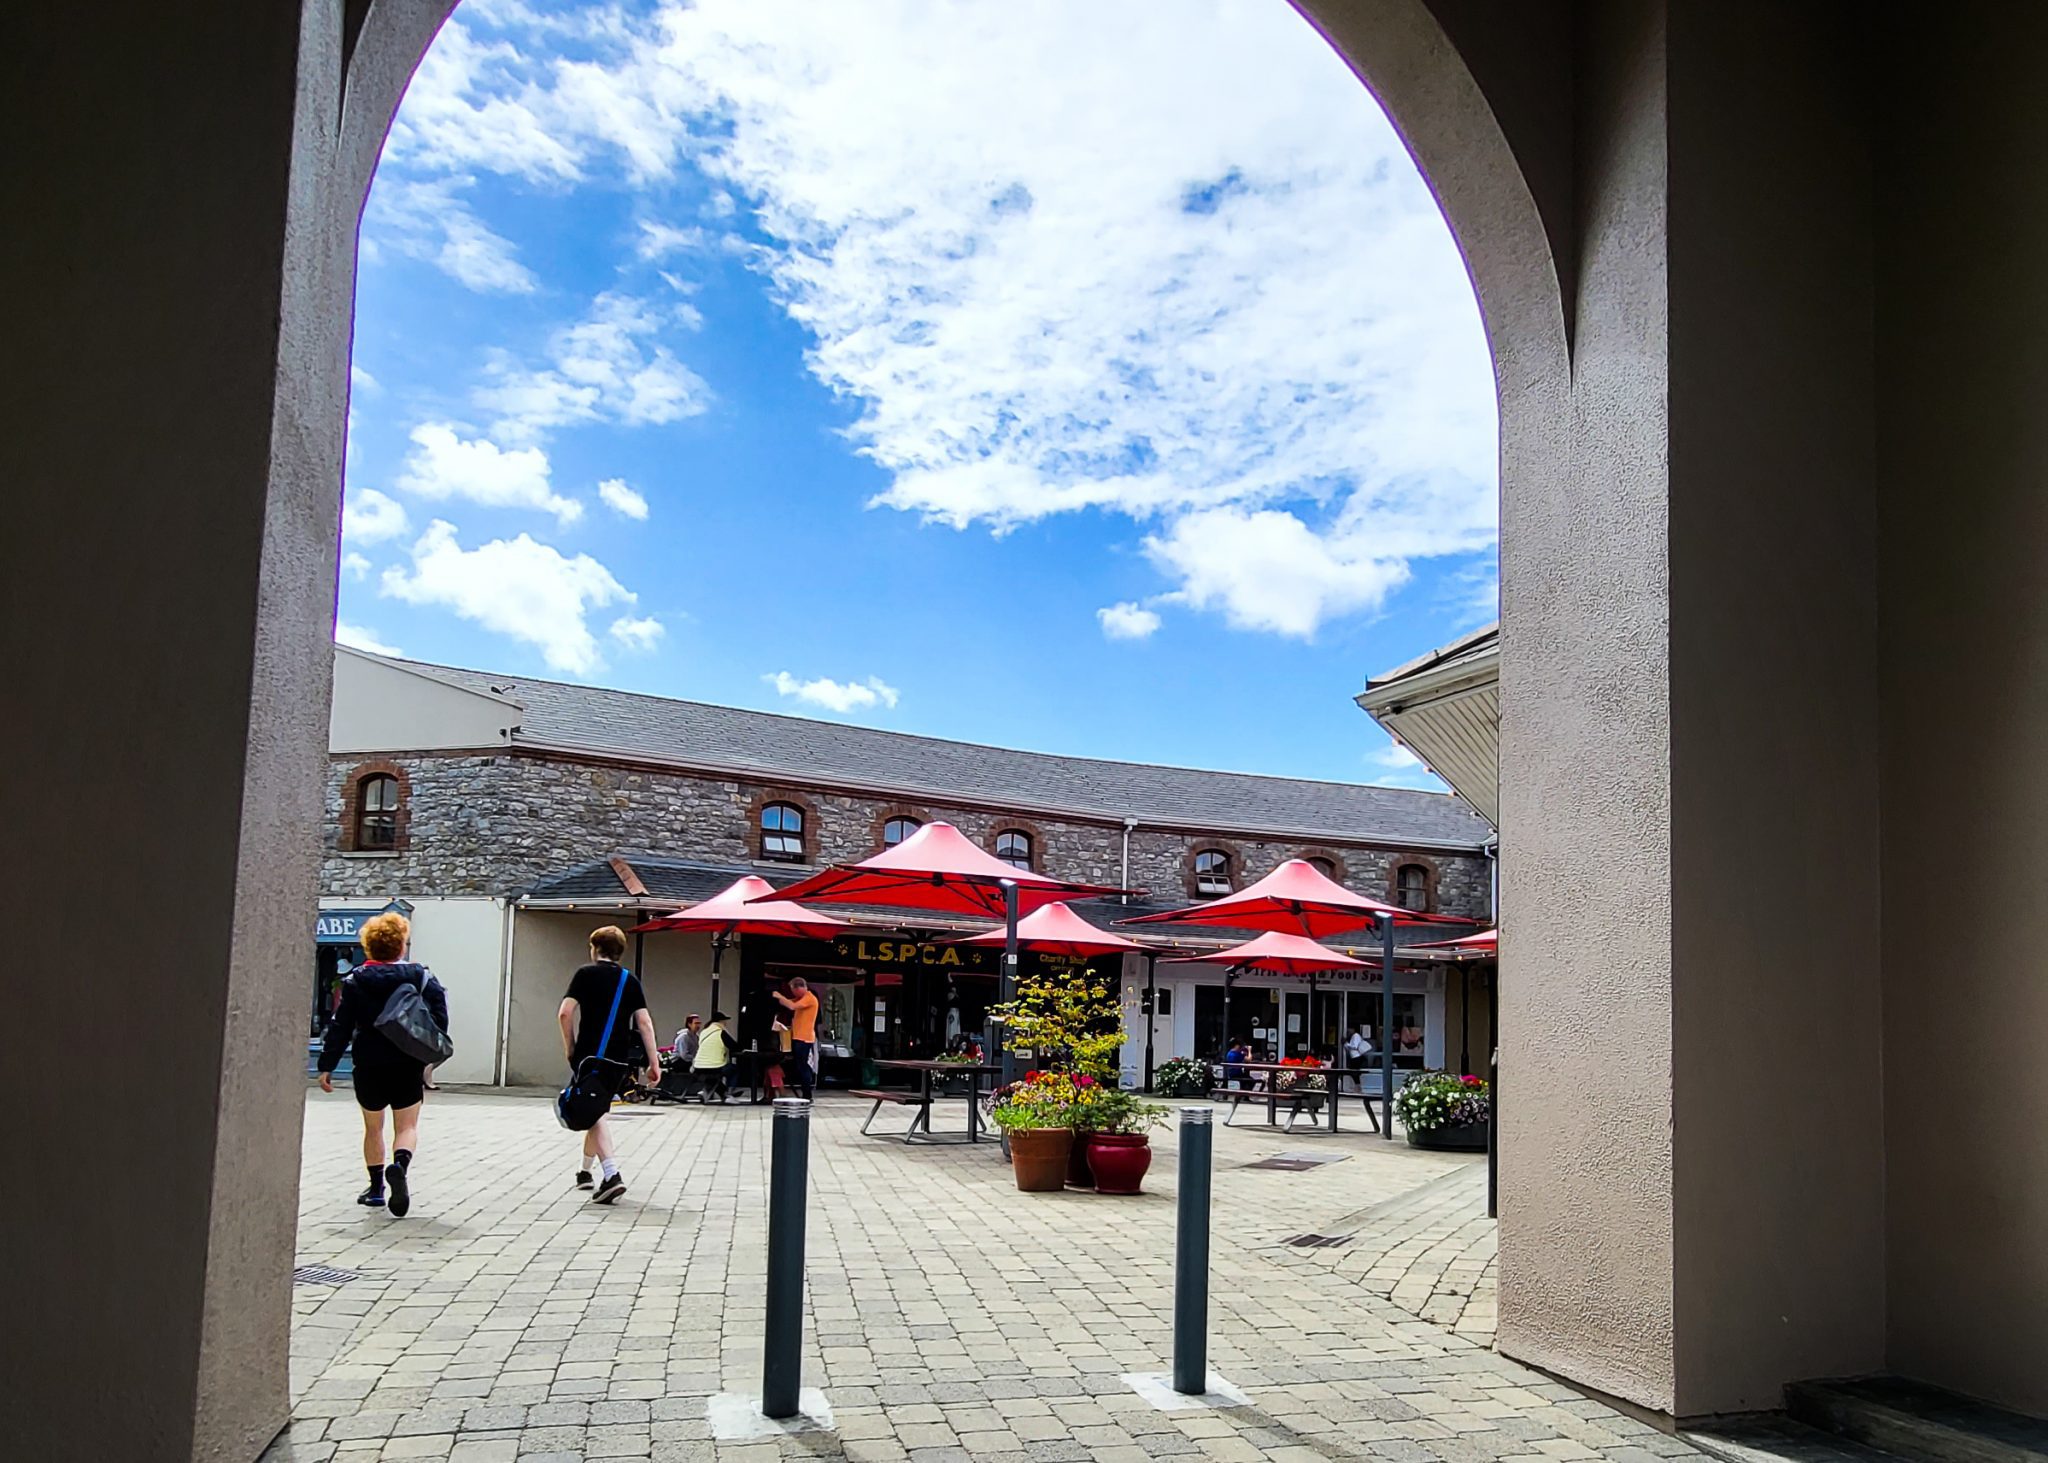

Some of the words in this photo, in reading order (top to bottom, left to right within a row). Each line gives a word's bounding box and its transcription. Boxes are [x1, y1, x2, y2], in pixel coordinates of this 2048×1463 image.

[857, 941, 965, 966] L.S.P.C.A.
[1330, 968, 1357, 980] Foot
[1361, 970, 1383, 983] Spa
